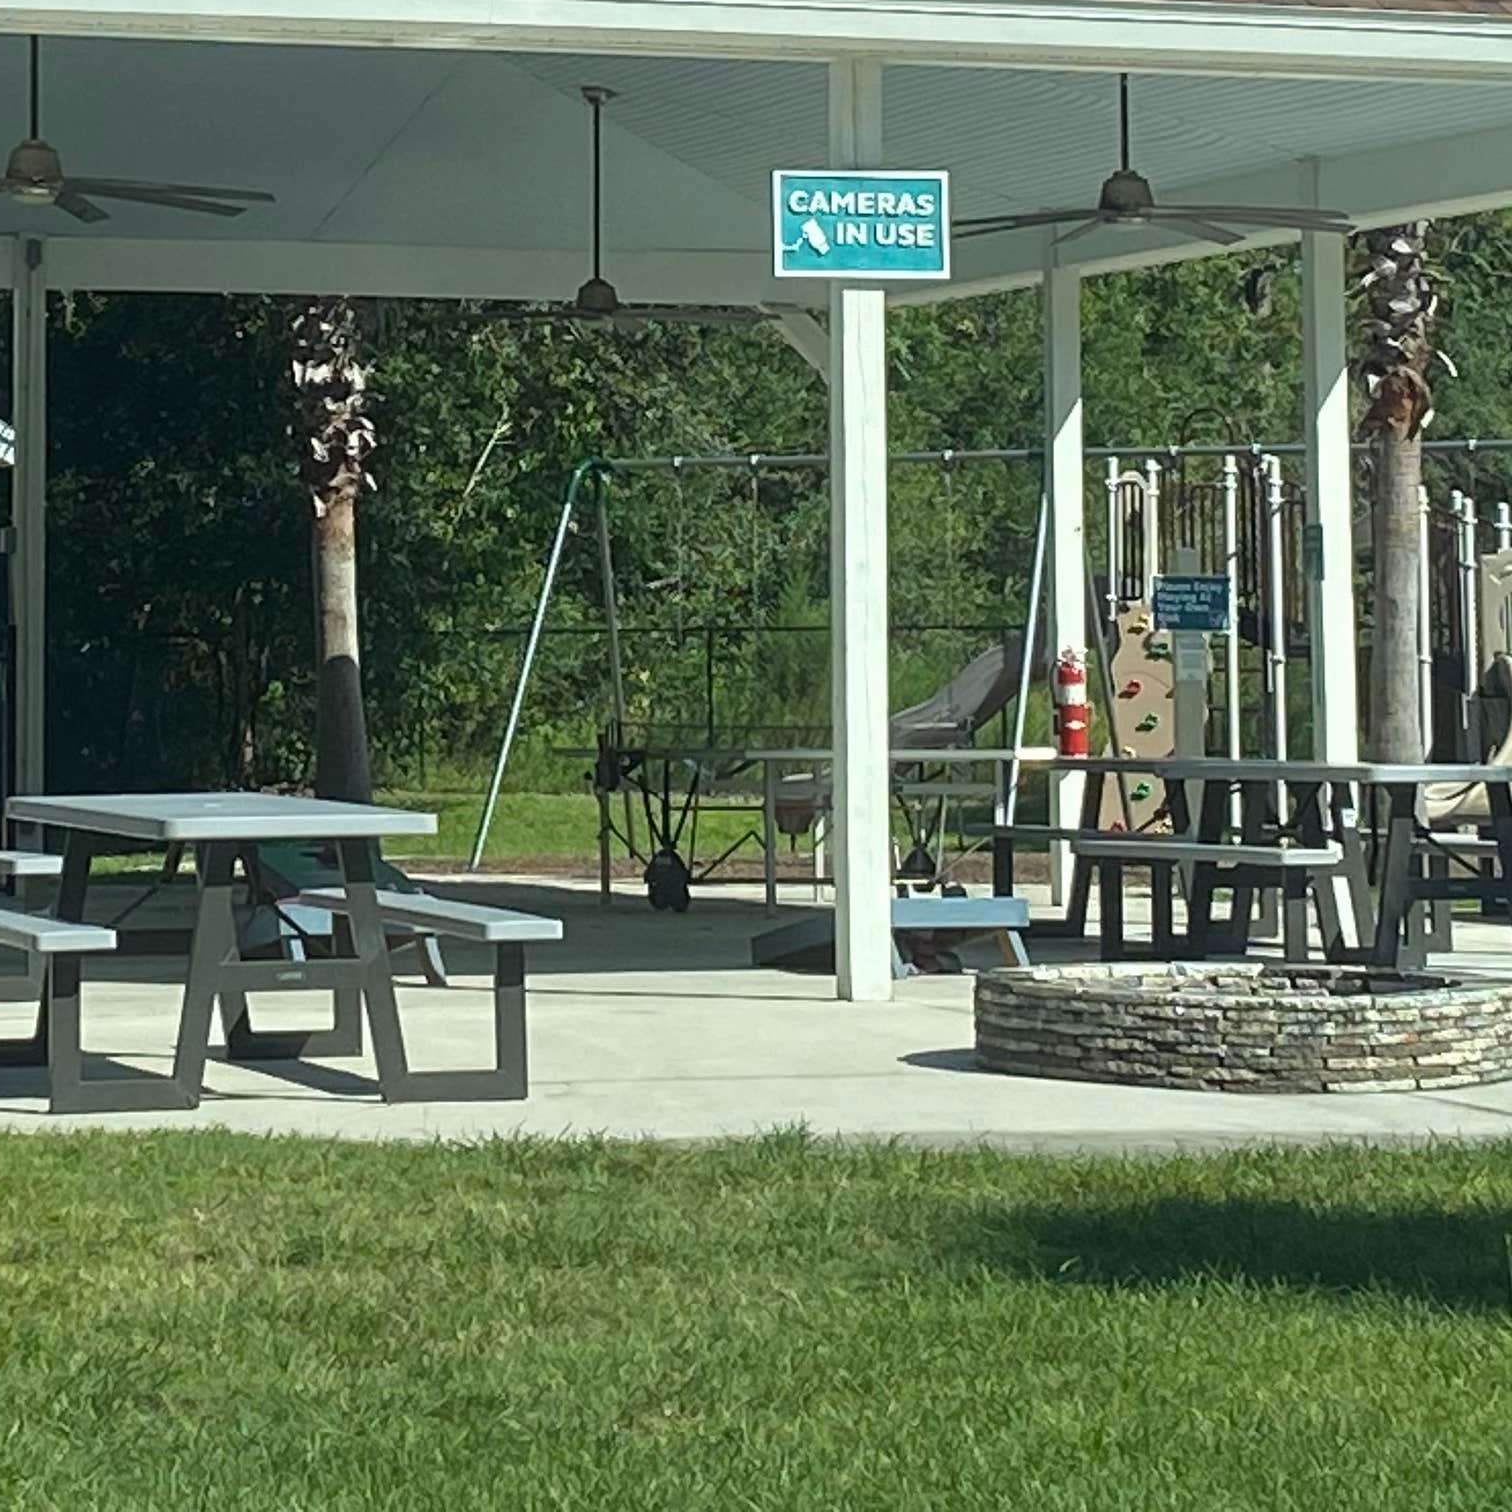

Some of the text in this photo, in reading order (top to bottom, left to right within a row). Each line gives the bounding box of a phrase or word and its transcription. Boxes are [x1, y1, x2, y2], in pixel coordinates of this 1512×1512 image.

[789, 190, 935, 217] CAMERAS
[837, 222, 936, 248] IN USE
